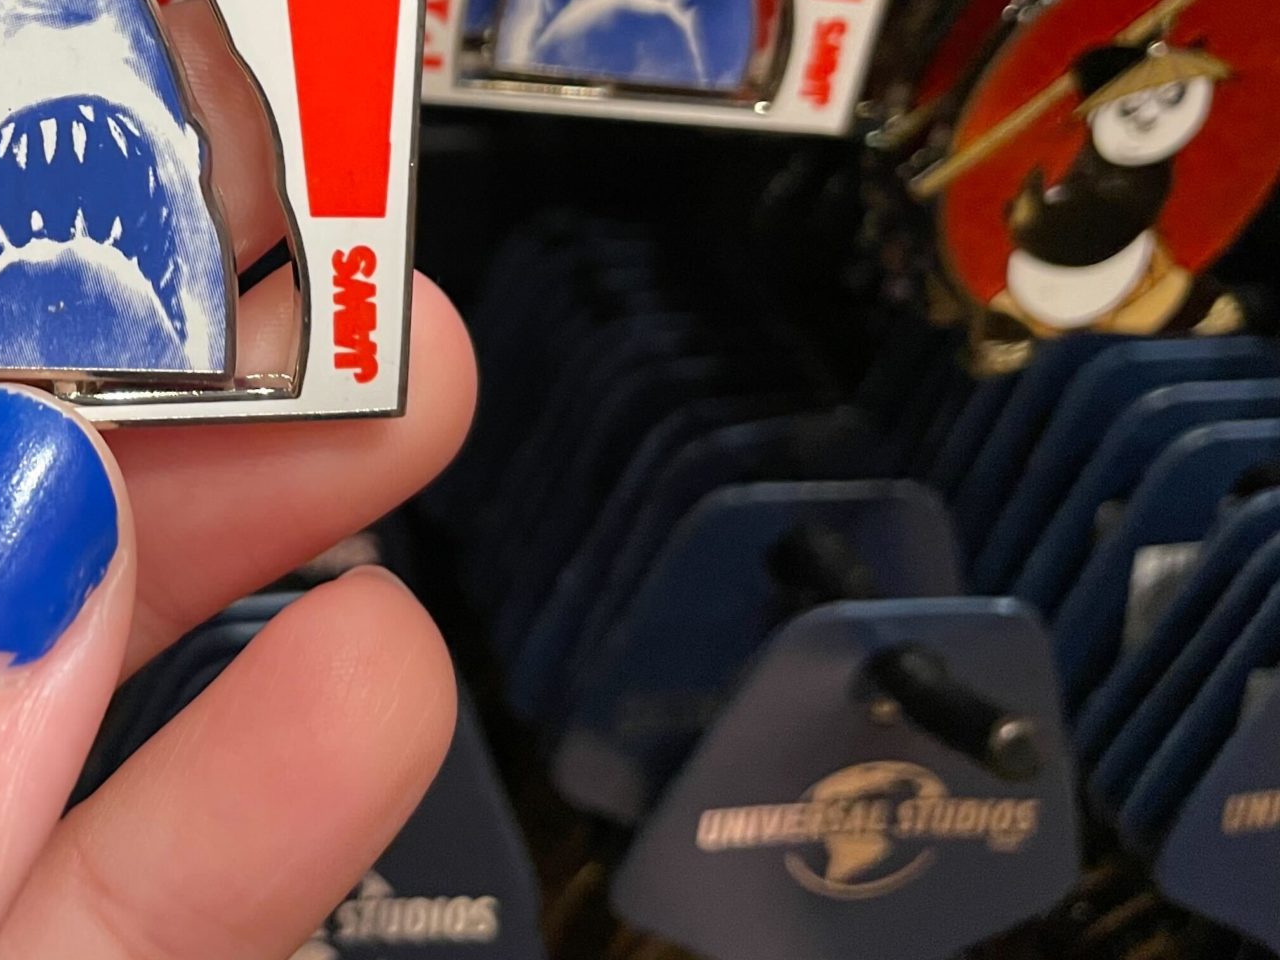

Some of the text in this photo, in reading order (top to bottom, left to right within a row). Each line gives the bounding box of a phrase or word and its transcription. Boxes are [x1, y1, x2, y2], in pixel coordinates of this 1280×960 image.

[332, 245, 379, 385] JAWS
[695, 796, 1040, 851] UNIVERSAL STUDIOS
[334, 895, 498, 941] STUDIOS
